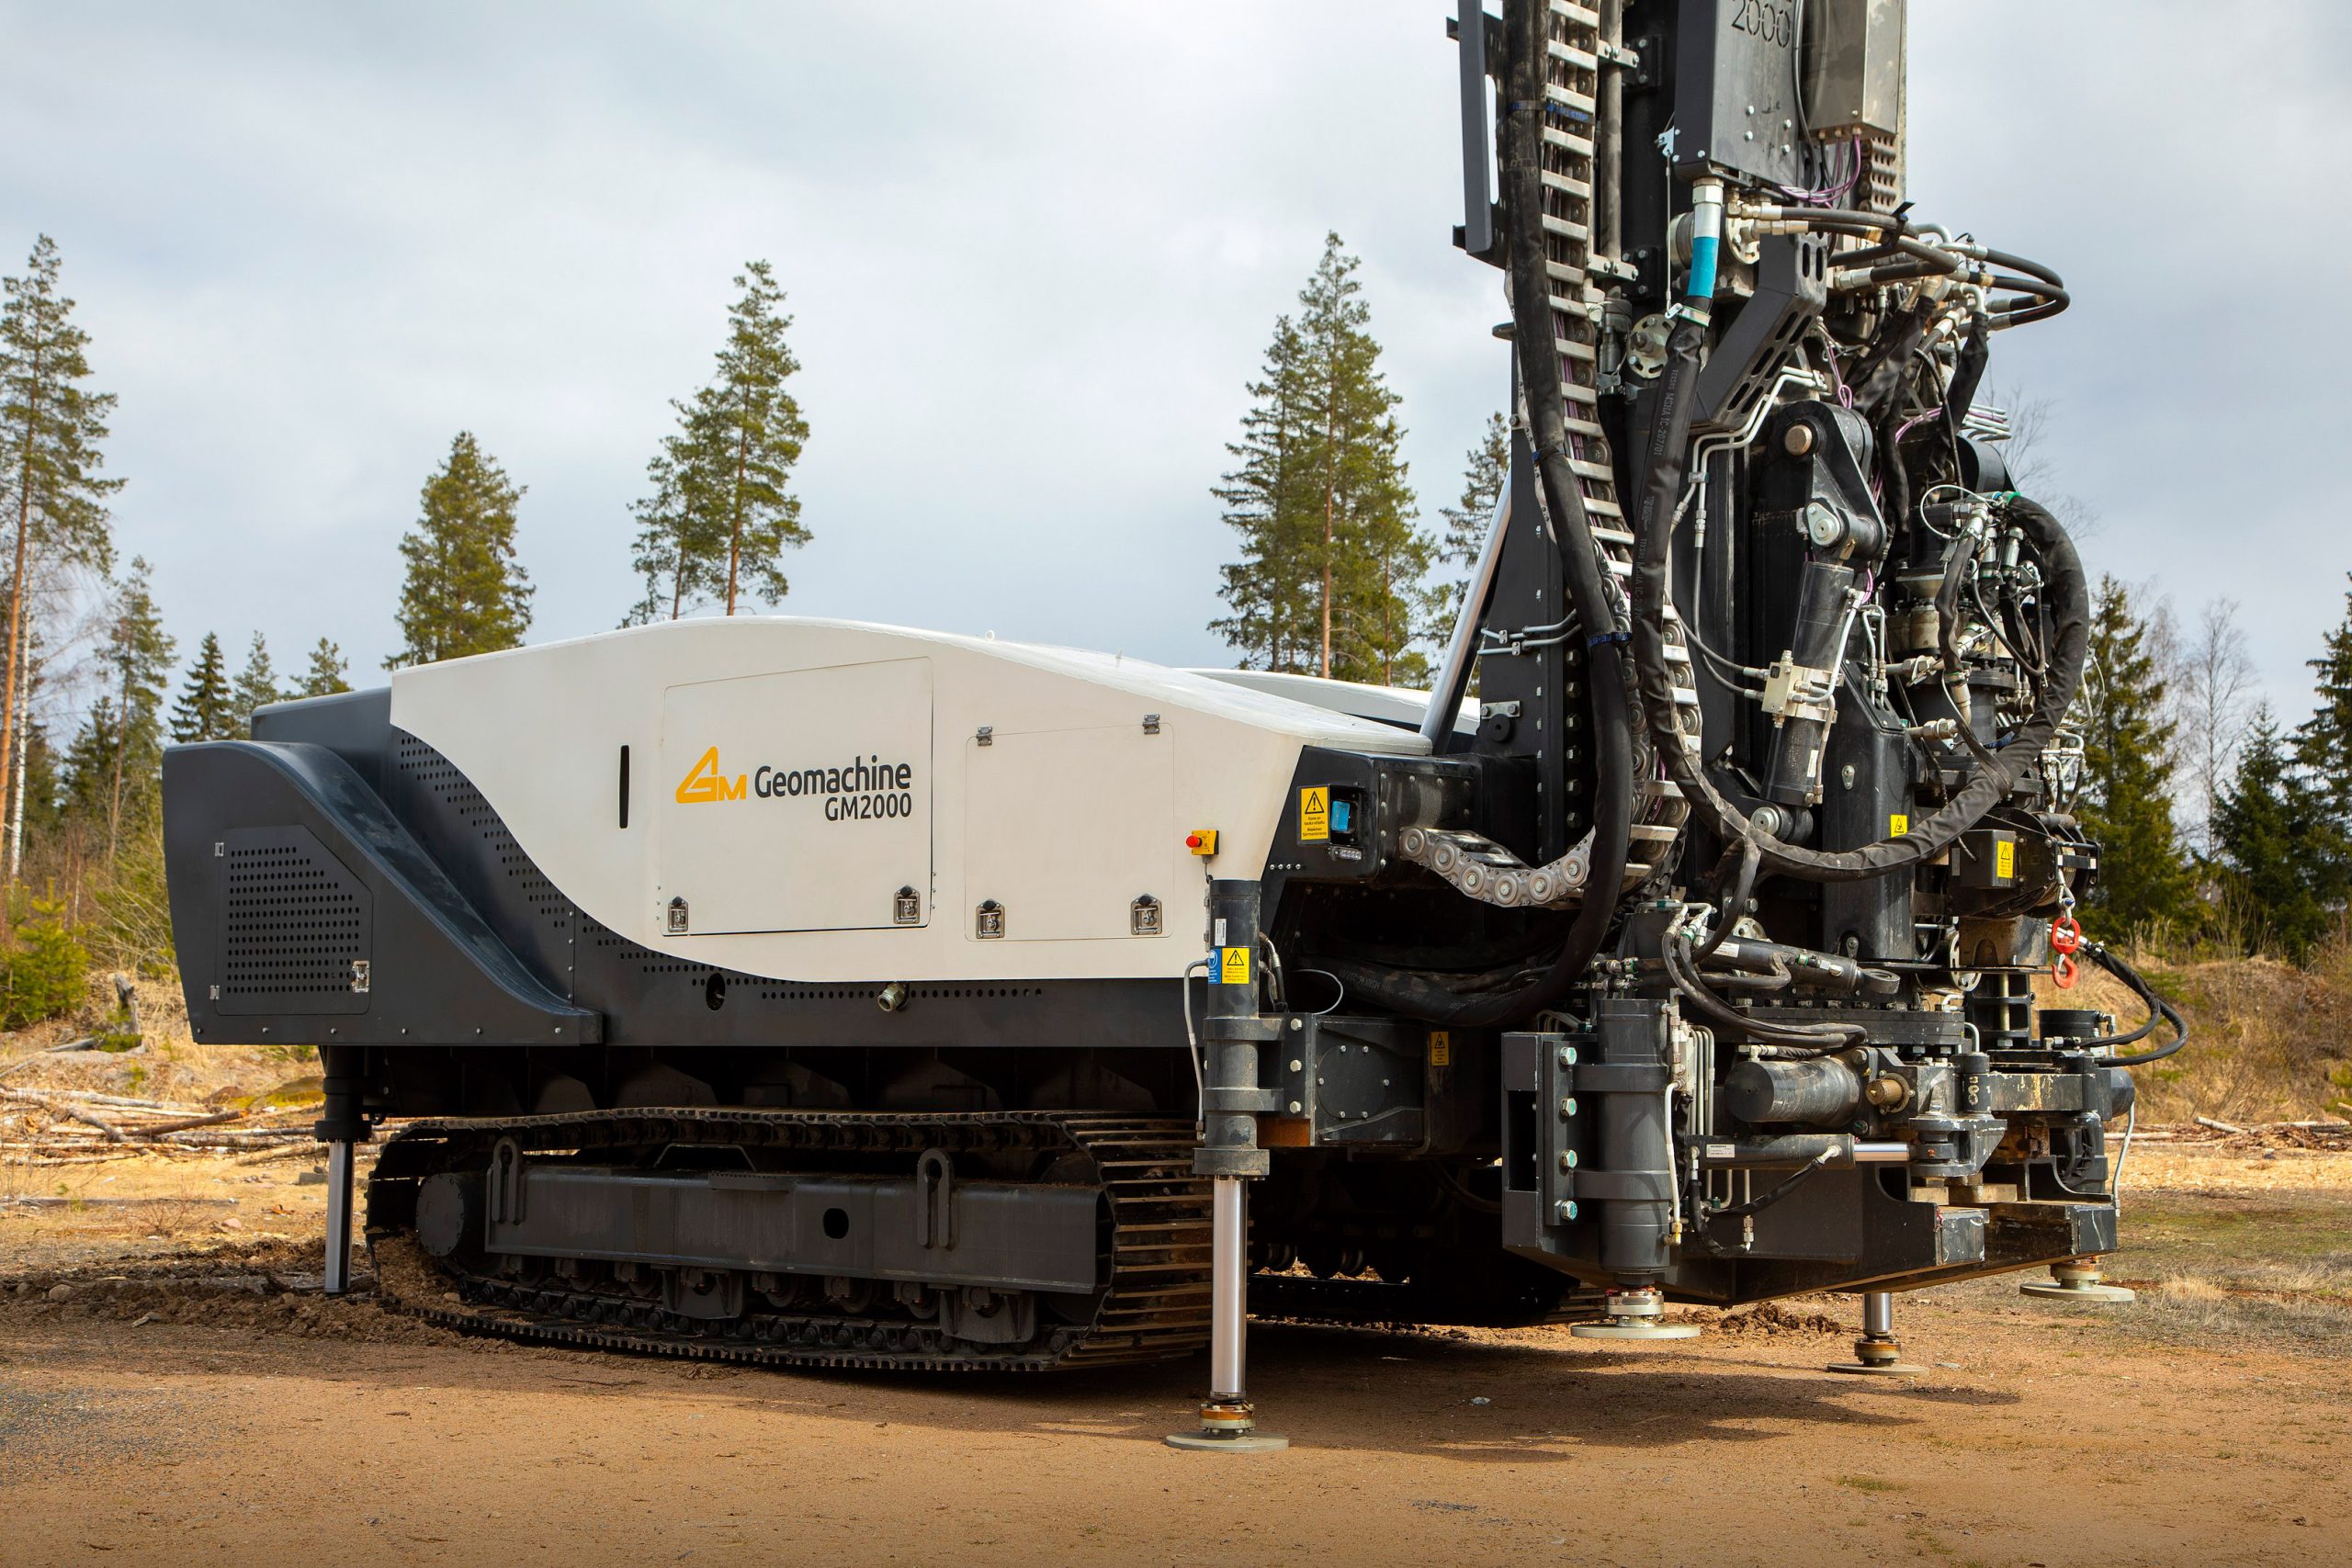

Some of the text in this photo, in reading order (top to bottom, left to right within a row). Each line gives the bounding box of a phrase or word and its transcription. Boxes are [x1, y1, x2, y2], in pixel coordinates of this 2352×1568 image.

[1731, 0, 1791, 48] 2000
[1661, 392, 1675, 415] MSHA
[754, 754, 911, 798] Geomachine
[825, 792, 911, 821] GM2000
